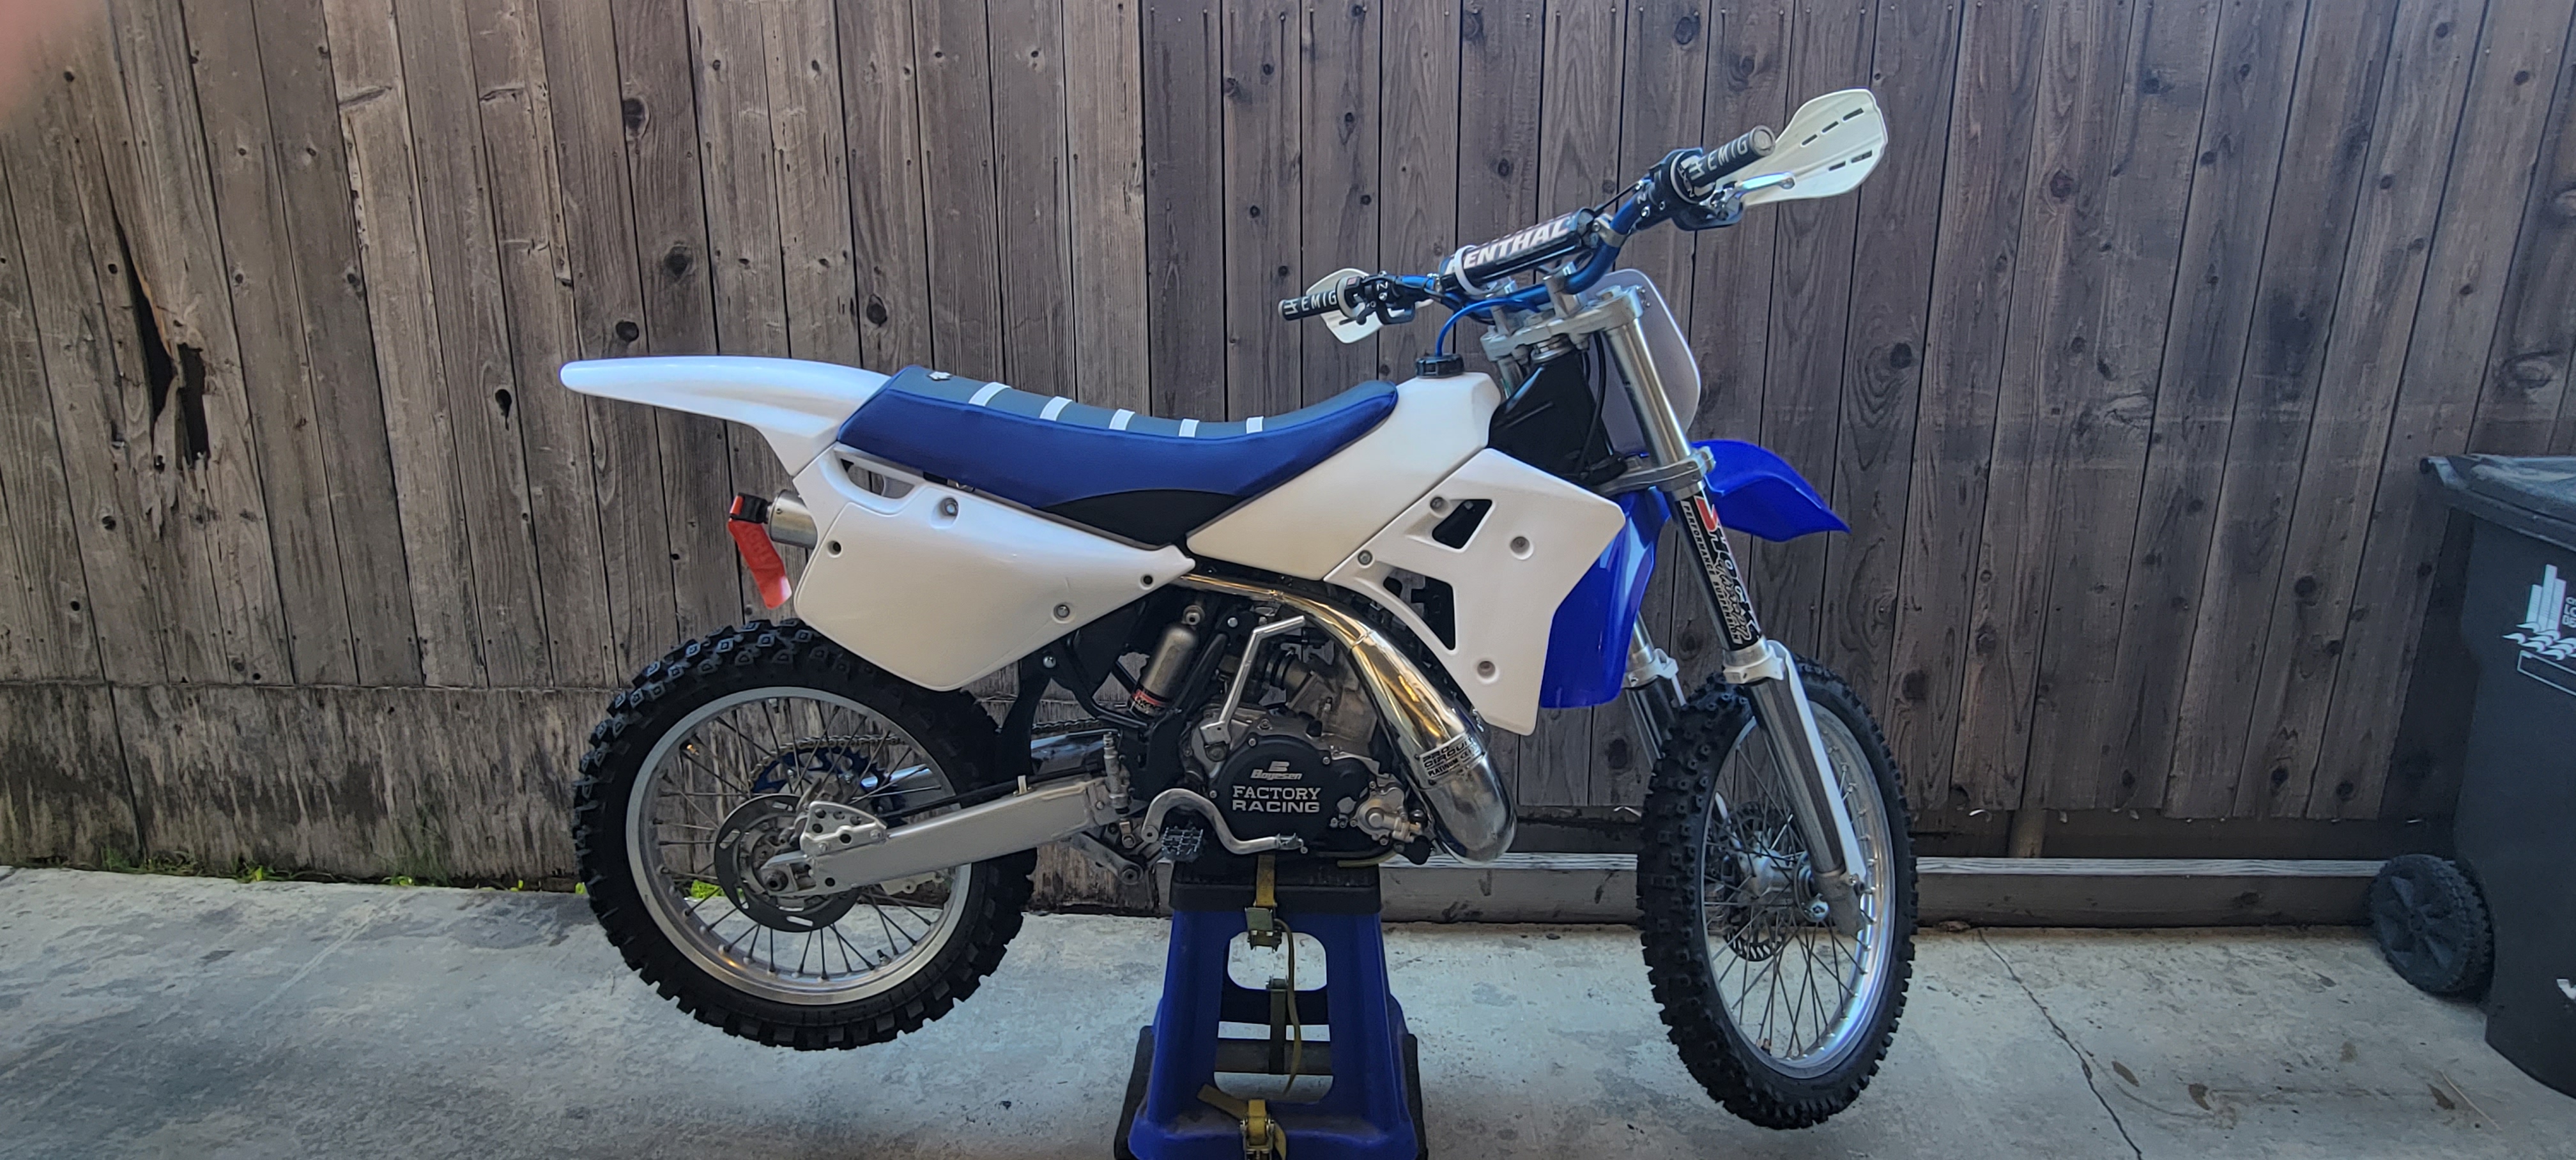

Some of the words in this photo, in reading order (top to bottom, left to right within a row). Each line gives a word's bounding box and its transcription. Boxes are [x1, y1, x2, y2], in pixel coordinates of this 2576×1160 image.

[1707, 132, 1748, 171] EMIG
[1301, 290, 1337, 311] EMIG
[1683, 505, 1716, 576] PERFORMANCE
[1713, 580, 1740, 641] SUSPENSION
[1250, 769, 1303, 781] Boyesen
[1427, 758, 1459, 777] PLATINUM
[1232, 785, 1321, 800] FACTORY
[1232, 800, 1320, 813] RACING
